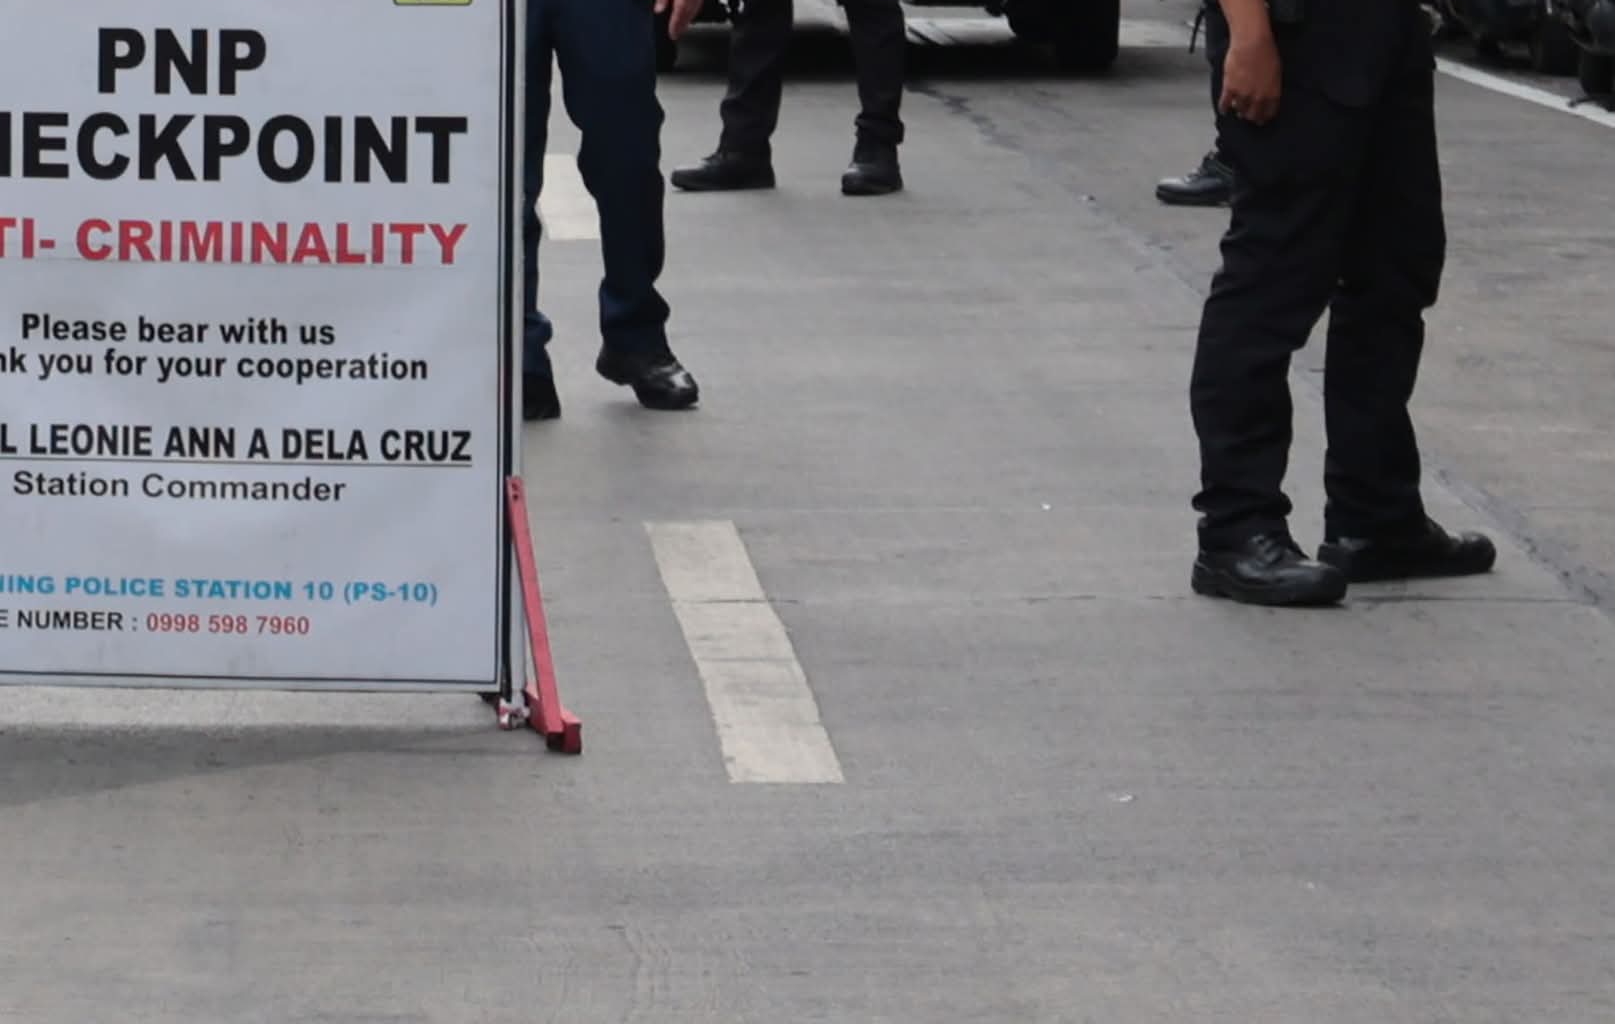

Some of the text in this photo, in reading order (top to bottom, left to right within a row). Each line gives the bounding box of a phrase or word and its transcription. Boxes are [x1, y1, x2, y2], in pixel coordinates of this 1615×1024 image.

[97, 27, 267, 96] PNP
[75, 218, 468, 266] CRIMINALITY
[21, 313, 336, 346] Please bear with us
[38, 353, 93, 381] you
[103, 349, 149, 377] for
[157, 356, 226, 383] your
[236, 352, 428, 384] cooperation
[28, 423, 152, 457] LEONIE
[163, 426, 235, 458] ANN
[247, 428, 270, 459] A
[282, 428, 369, 460] DELA
[380, 430, 473, 462] CRUZ
[13, 469, 347, 502] Station Commander
[64, 575, 165, 598] POLICE
[174, 578, 294, 601] STATION
[303, 580, 335, 601] 10
[343, 581, 438, 607] (PS-10)
[16, 609, 124, 632] NUMBER
[146, 612, 200, 634] 0998
[208, 614, 248, 634] 598
[255, 615, 310, 636] 7960
